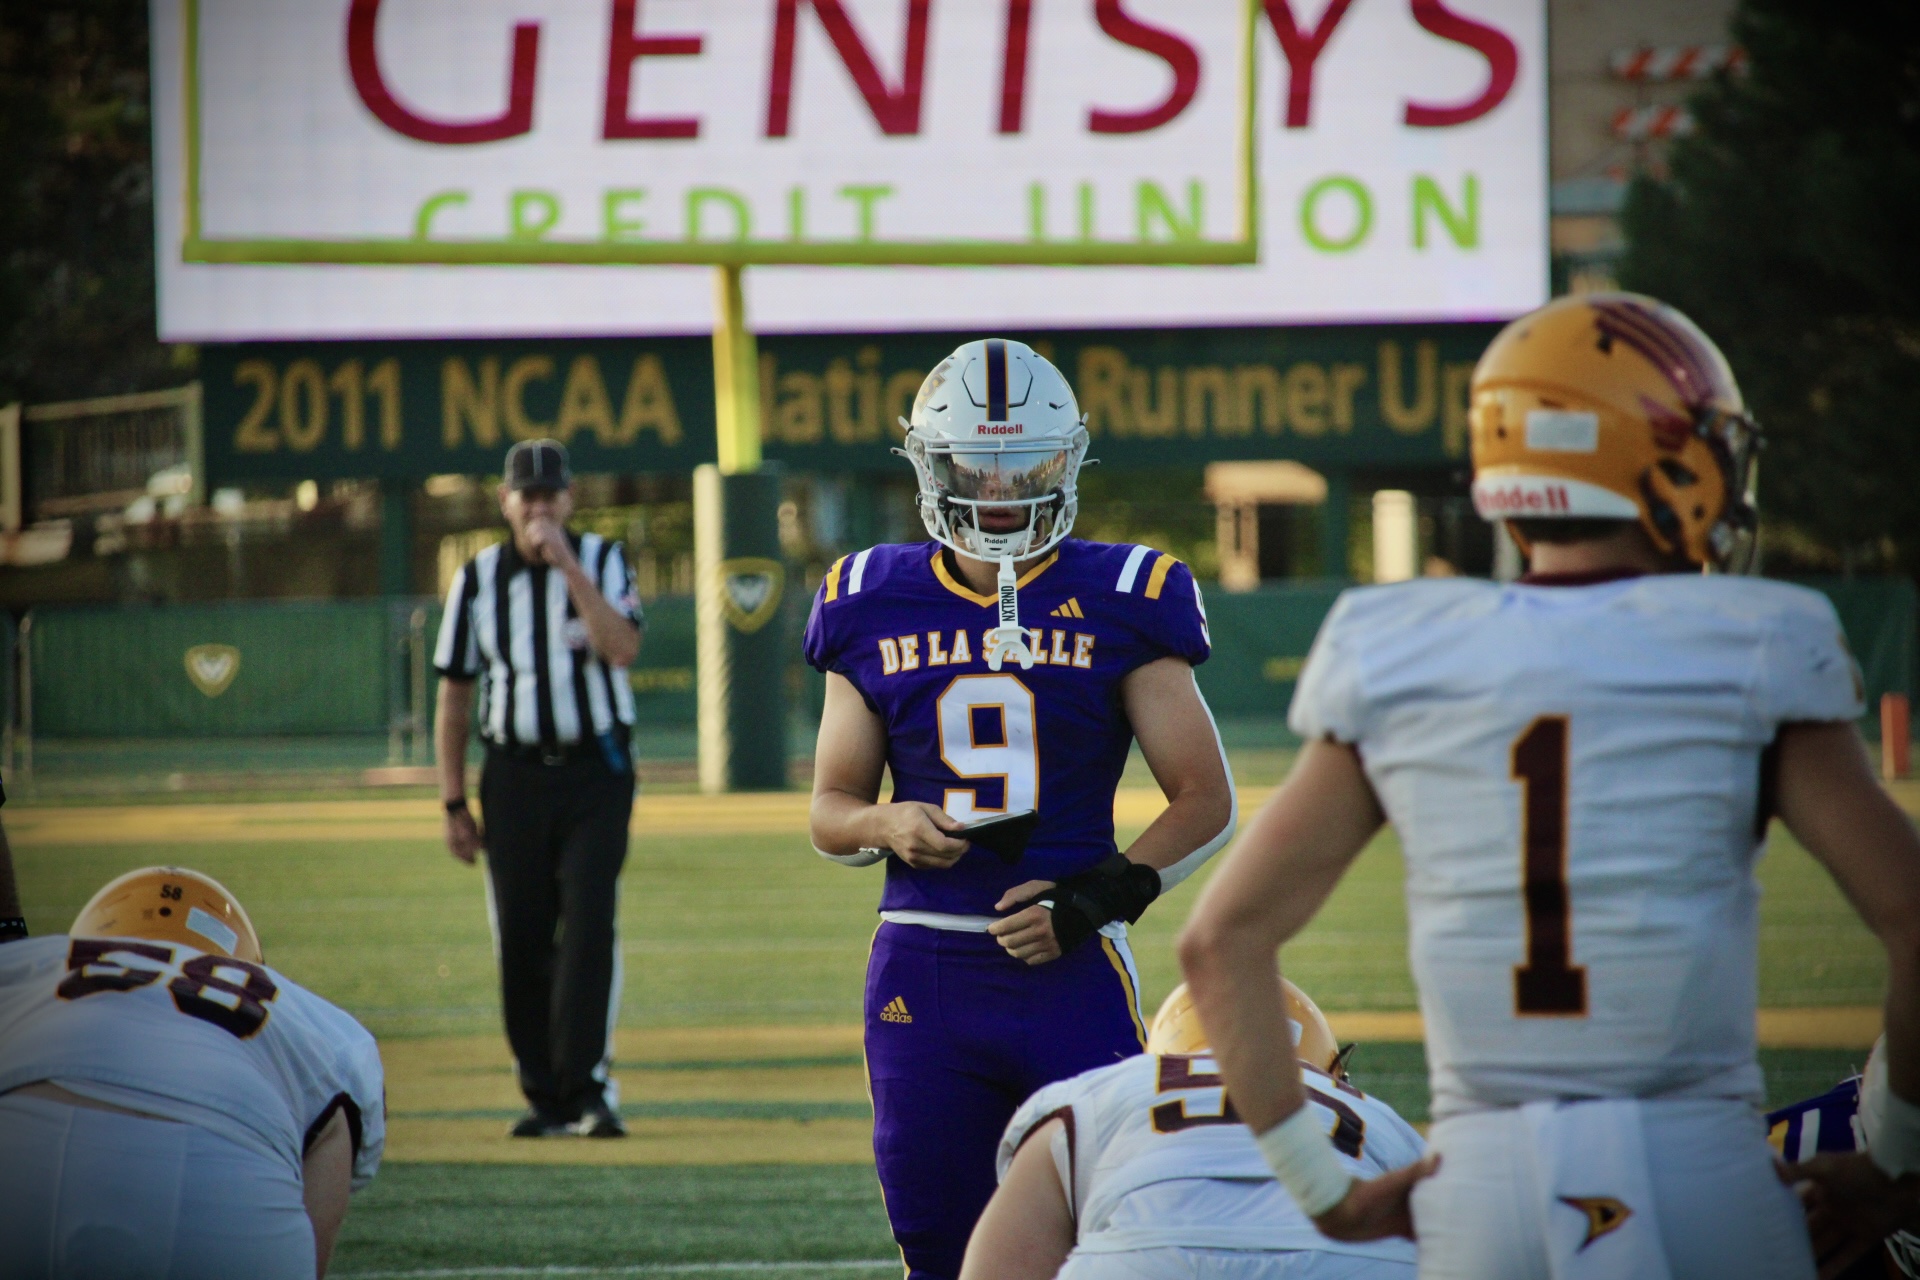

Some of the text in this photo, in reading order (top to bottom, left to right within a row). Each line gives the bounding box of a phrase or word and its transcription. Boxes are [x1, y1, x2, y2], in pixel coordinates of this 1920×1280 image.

[345, 0, 1519, 145] GENISYS
[1027, 174, 1480, 253] UNON
[233, 358, 401, 452] 2011
[441, 354, 682, 448] NCAA
[1076, 345, 1366, 438] Runner
[977, 424, 1023, 435] Riddell
[1001, 585, 1015, 622] NXTRND
[878, 634, 919, 675] DE
[927, 629, 972, 666] LA
[936, 672, 1040, 823] 9
[160, 884, 183, 900] 58
[1510, 713, 1590, 1018] 1
[55, 938, 283, 1041] 58
[880, 1011, 913, 1024] adidas
